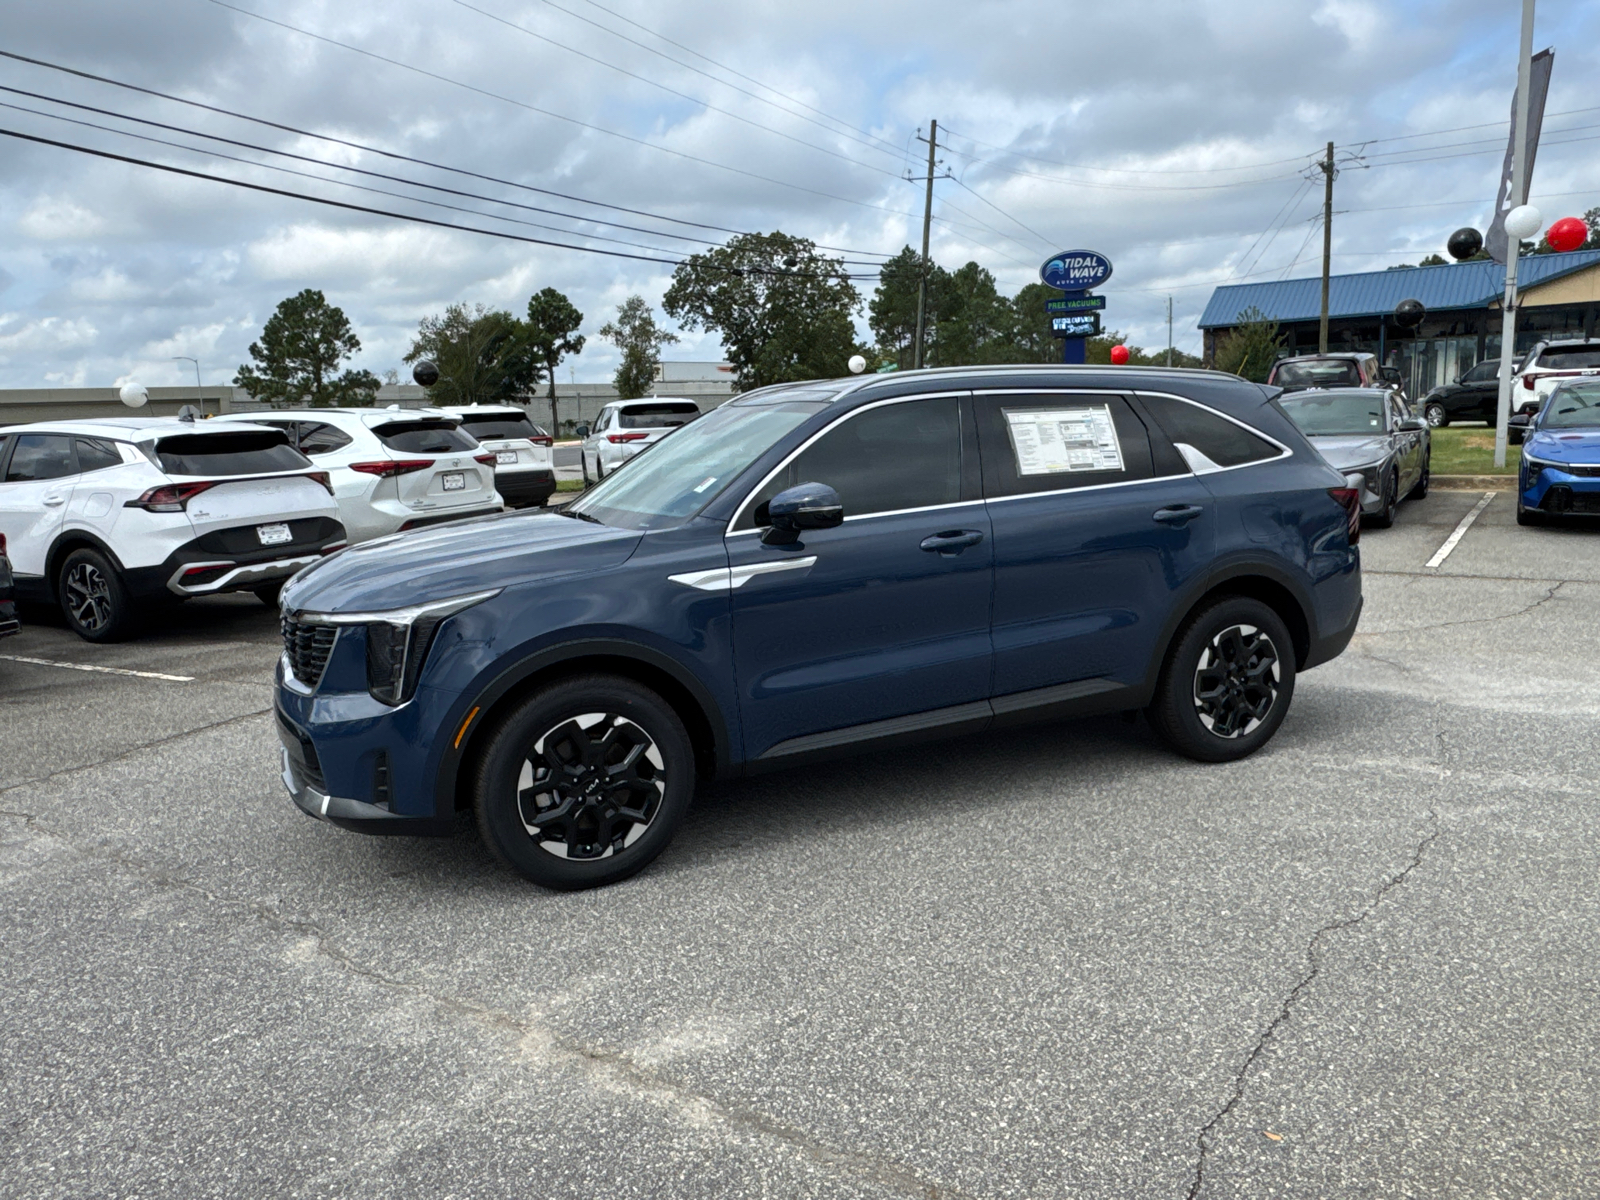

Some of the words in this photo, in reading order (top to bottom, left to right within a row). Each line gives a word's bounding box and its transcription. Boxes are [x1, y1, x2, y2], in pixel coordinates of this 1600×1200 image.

[1065, 257, 1097, 268] TIDAL
[1070, 266, 1104, 278] WAVE
[1067, 299, 1101, 308] VACUUMS
